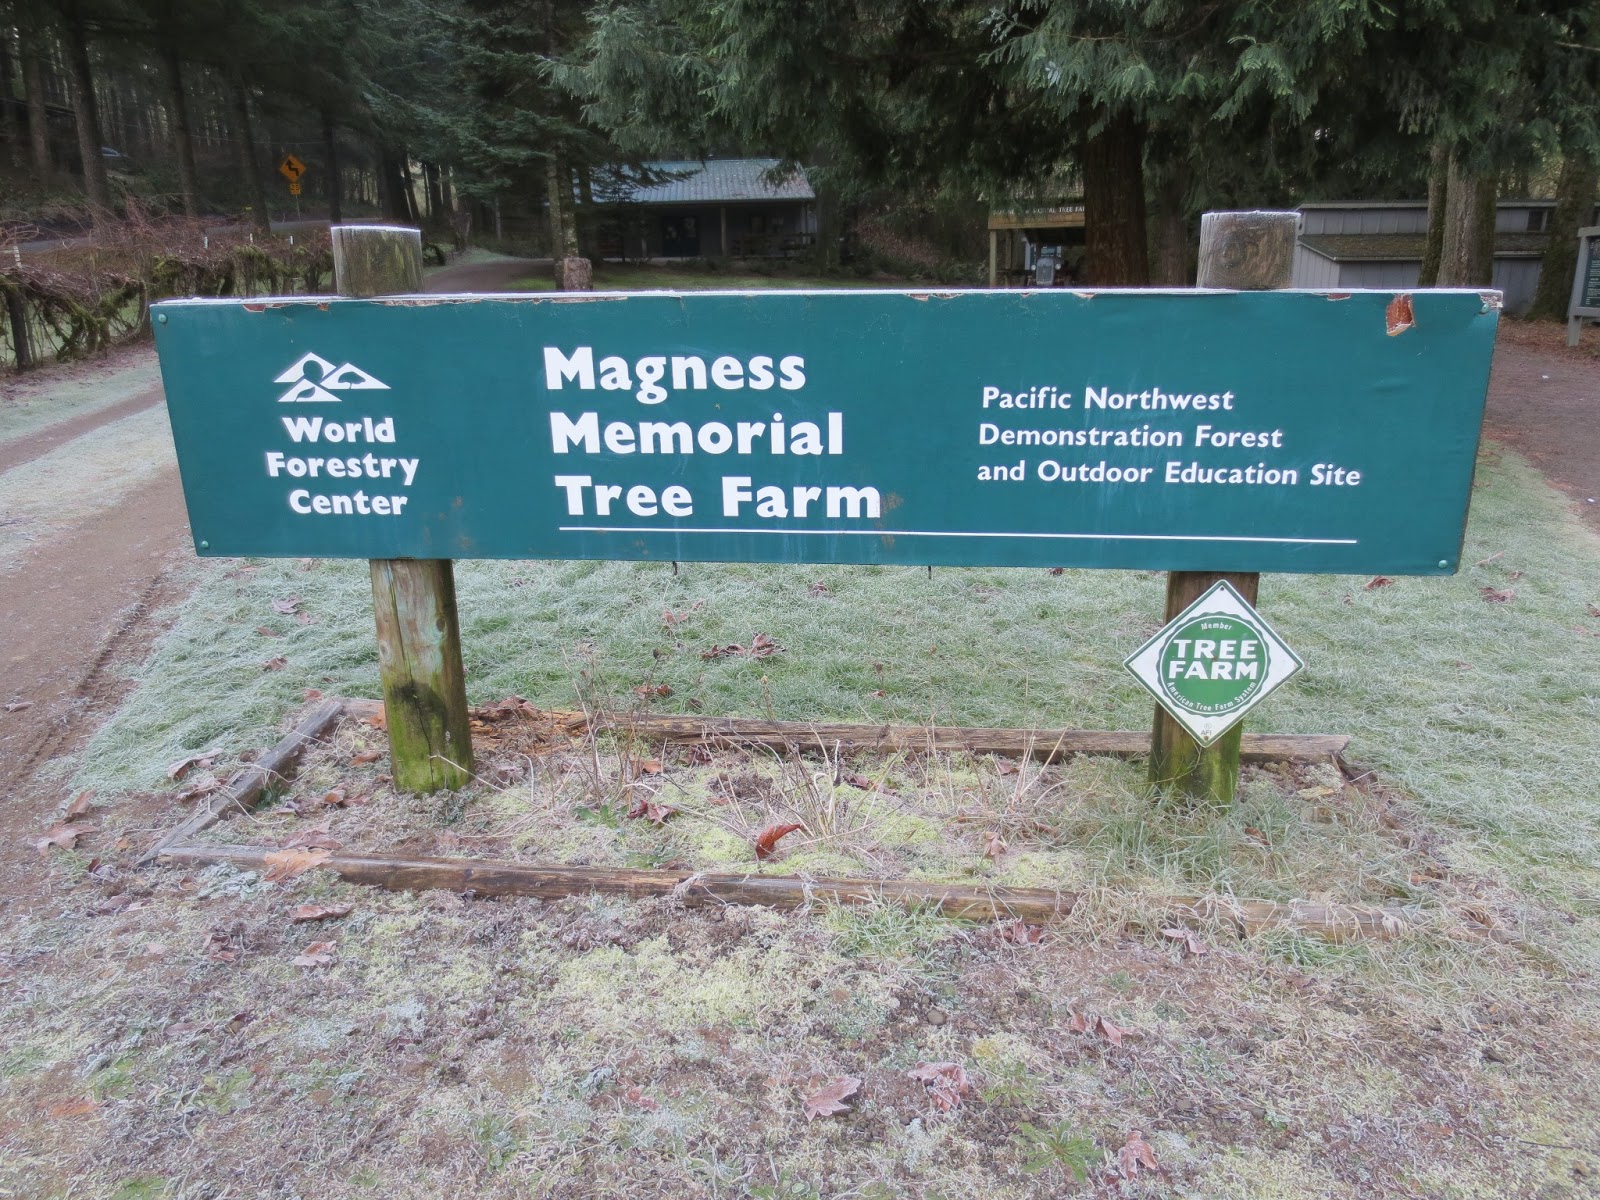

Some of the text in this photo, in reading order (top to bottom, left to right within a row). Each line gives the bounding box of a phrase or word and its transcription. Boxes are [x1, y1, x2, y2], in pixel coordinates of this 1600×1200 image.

[543, 346, 806, 405] Magness
[982, 386, 1235, 410] Pacific Northwest
[281, 416, 396, 443] World
[549, 411, 844, 456] Memorial
[978, 423, 1283, 448] Demonstration Forest
[265, 451, 420, 486] Forestry
[977, 459, 1362, 487] and Outdoor Education Site
[288, 489, 409, 516] Center
[554, 475, 882, 519] Tree Farm
[1201, 621, 1233, 631] Member
[1172, 639, 1258, 660] TREE
[1168, 660, 1258, 680] FARM
[1166, 681, 1257, 712] American Tree Farm System
